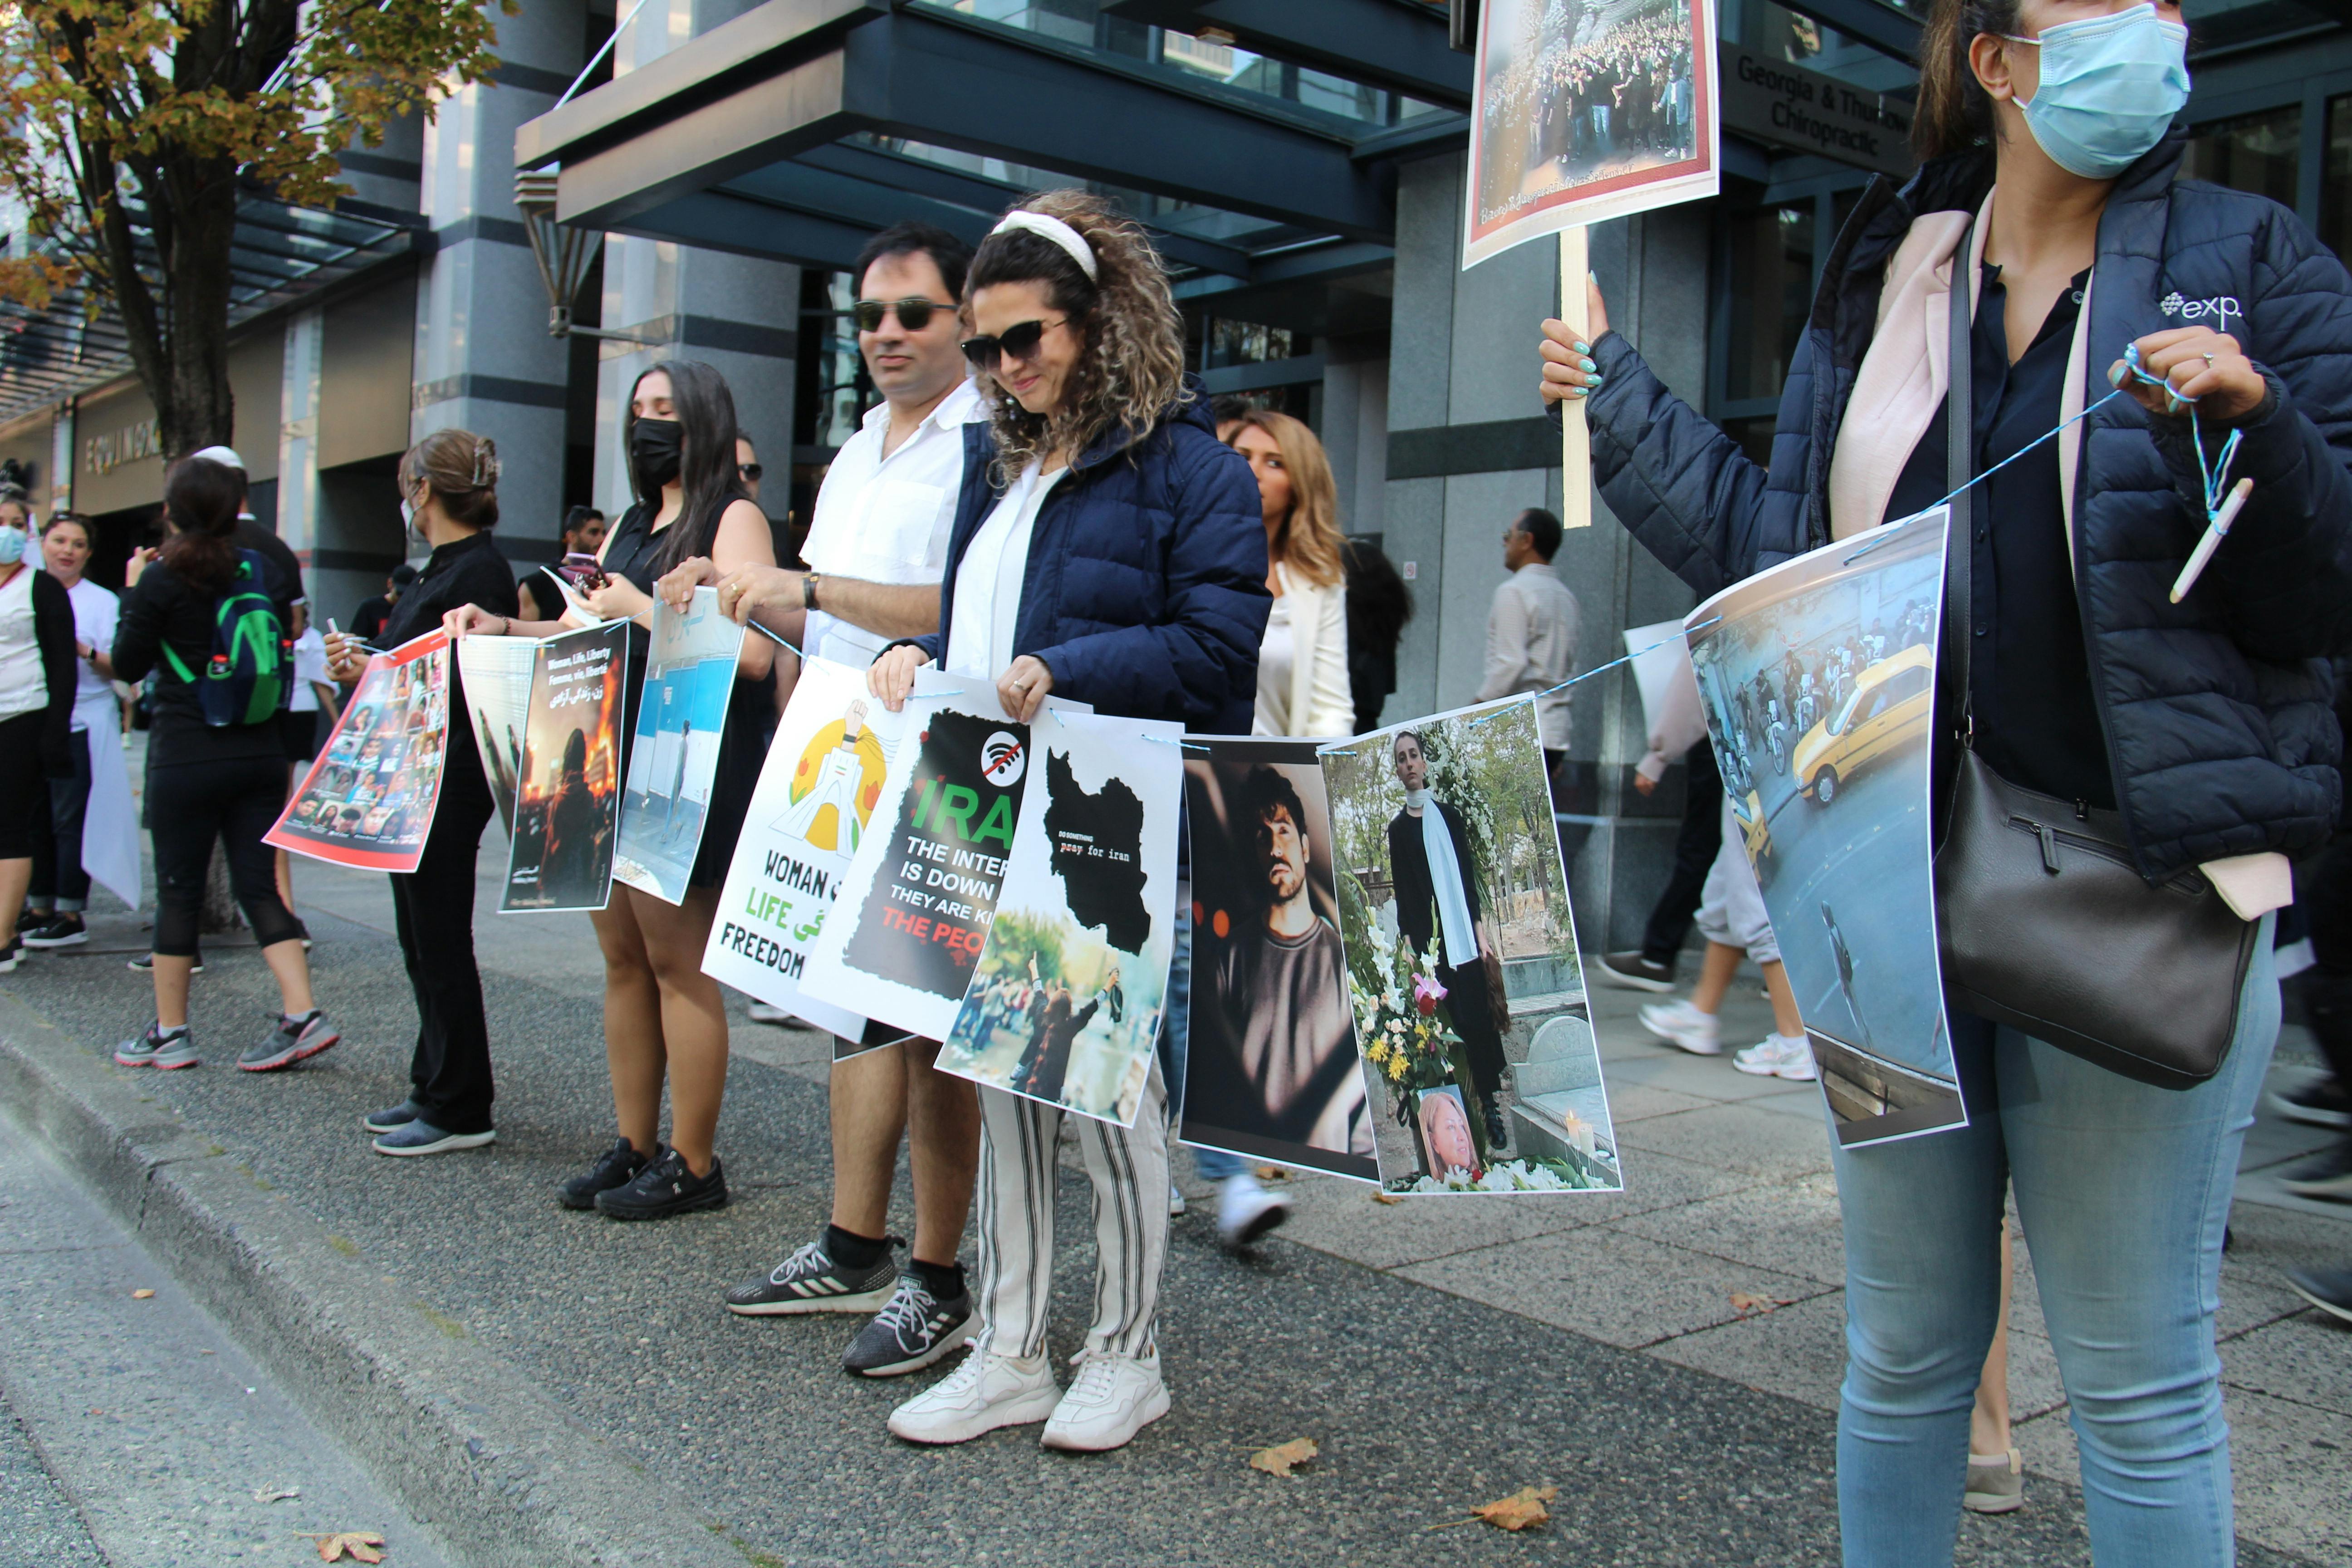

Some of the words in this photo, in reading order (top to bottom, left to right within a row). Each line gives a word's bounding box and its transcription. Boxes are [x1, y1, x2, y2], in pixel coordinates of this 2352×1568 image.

[1738, 56, 1813, 103] Georgia
[1821, 84, 1835, 111] &
[1772, 101, 1879, 156] Chiropractic
[573, 652, 586, 664] Life,
[586, 647, 611, 661] Liberty
[911, 779, 1014, 850] IRA
[907, 835, 949, 863] THE
[1060, 843, 1083, 855] pray
[1088, 845, 1104, 857] for
[1108, 849, 1130, 862] iran
[764, 849, 829, 899] WOMAN
[900, 861, 922, 882] IS
[925, 869, 995, 901] DOWN
[745, 887, 793, 930] LIFE
[882, 906, 927, 939] THE
[890, 884, 935, 909] THEY
[934, 897, 972, 920] ARE
[720, 922, 805, 980] FREEDOM
